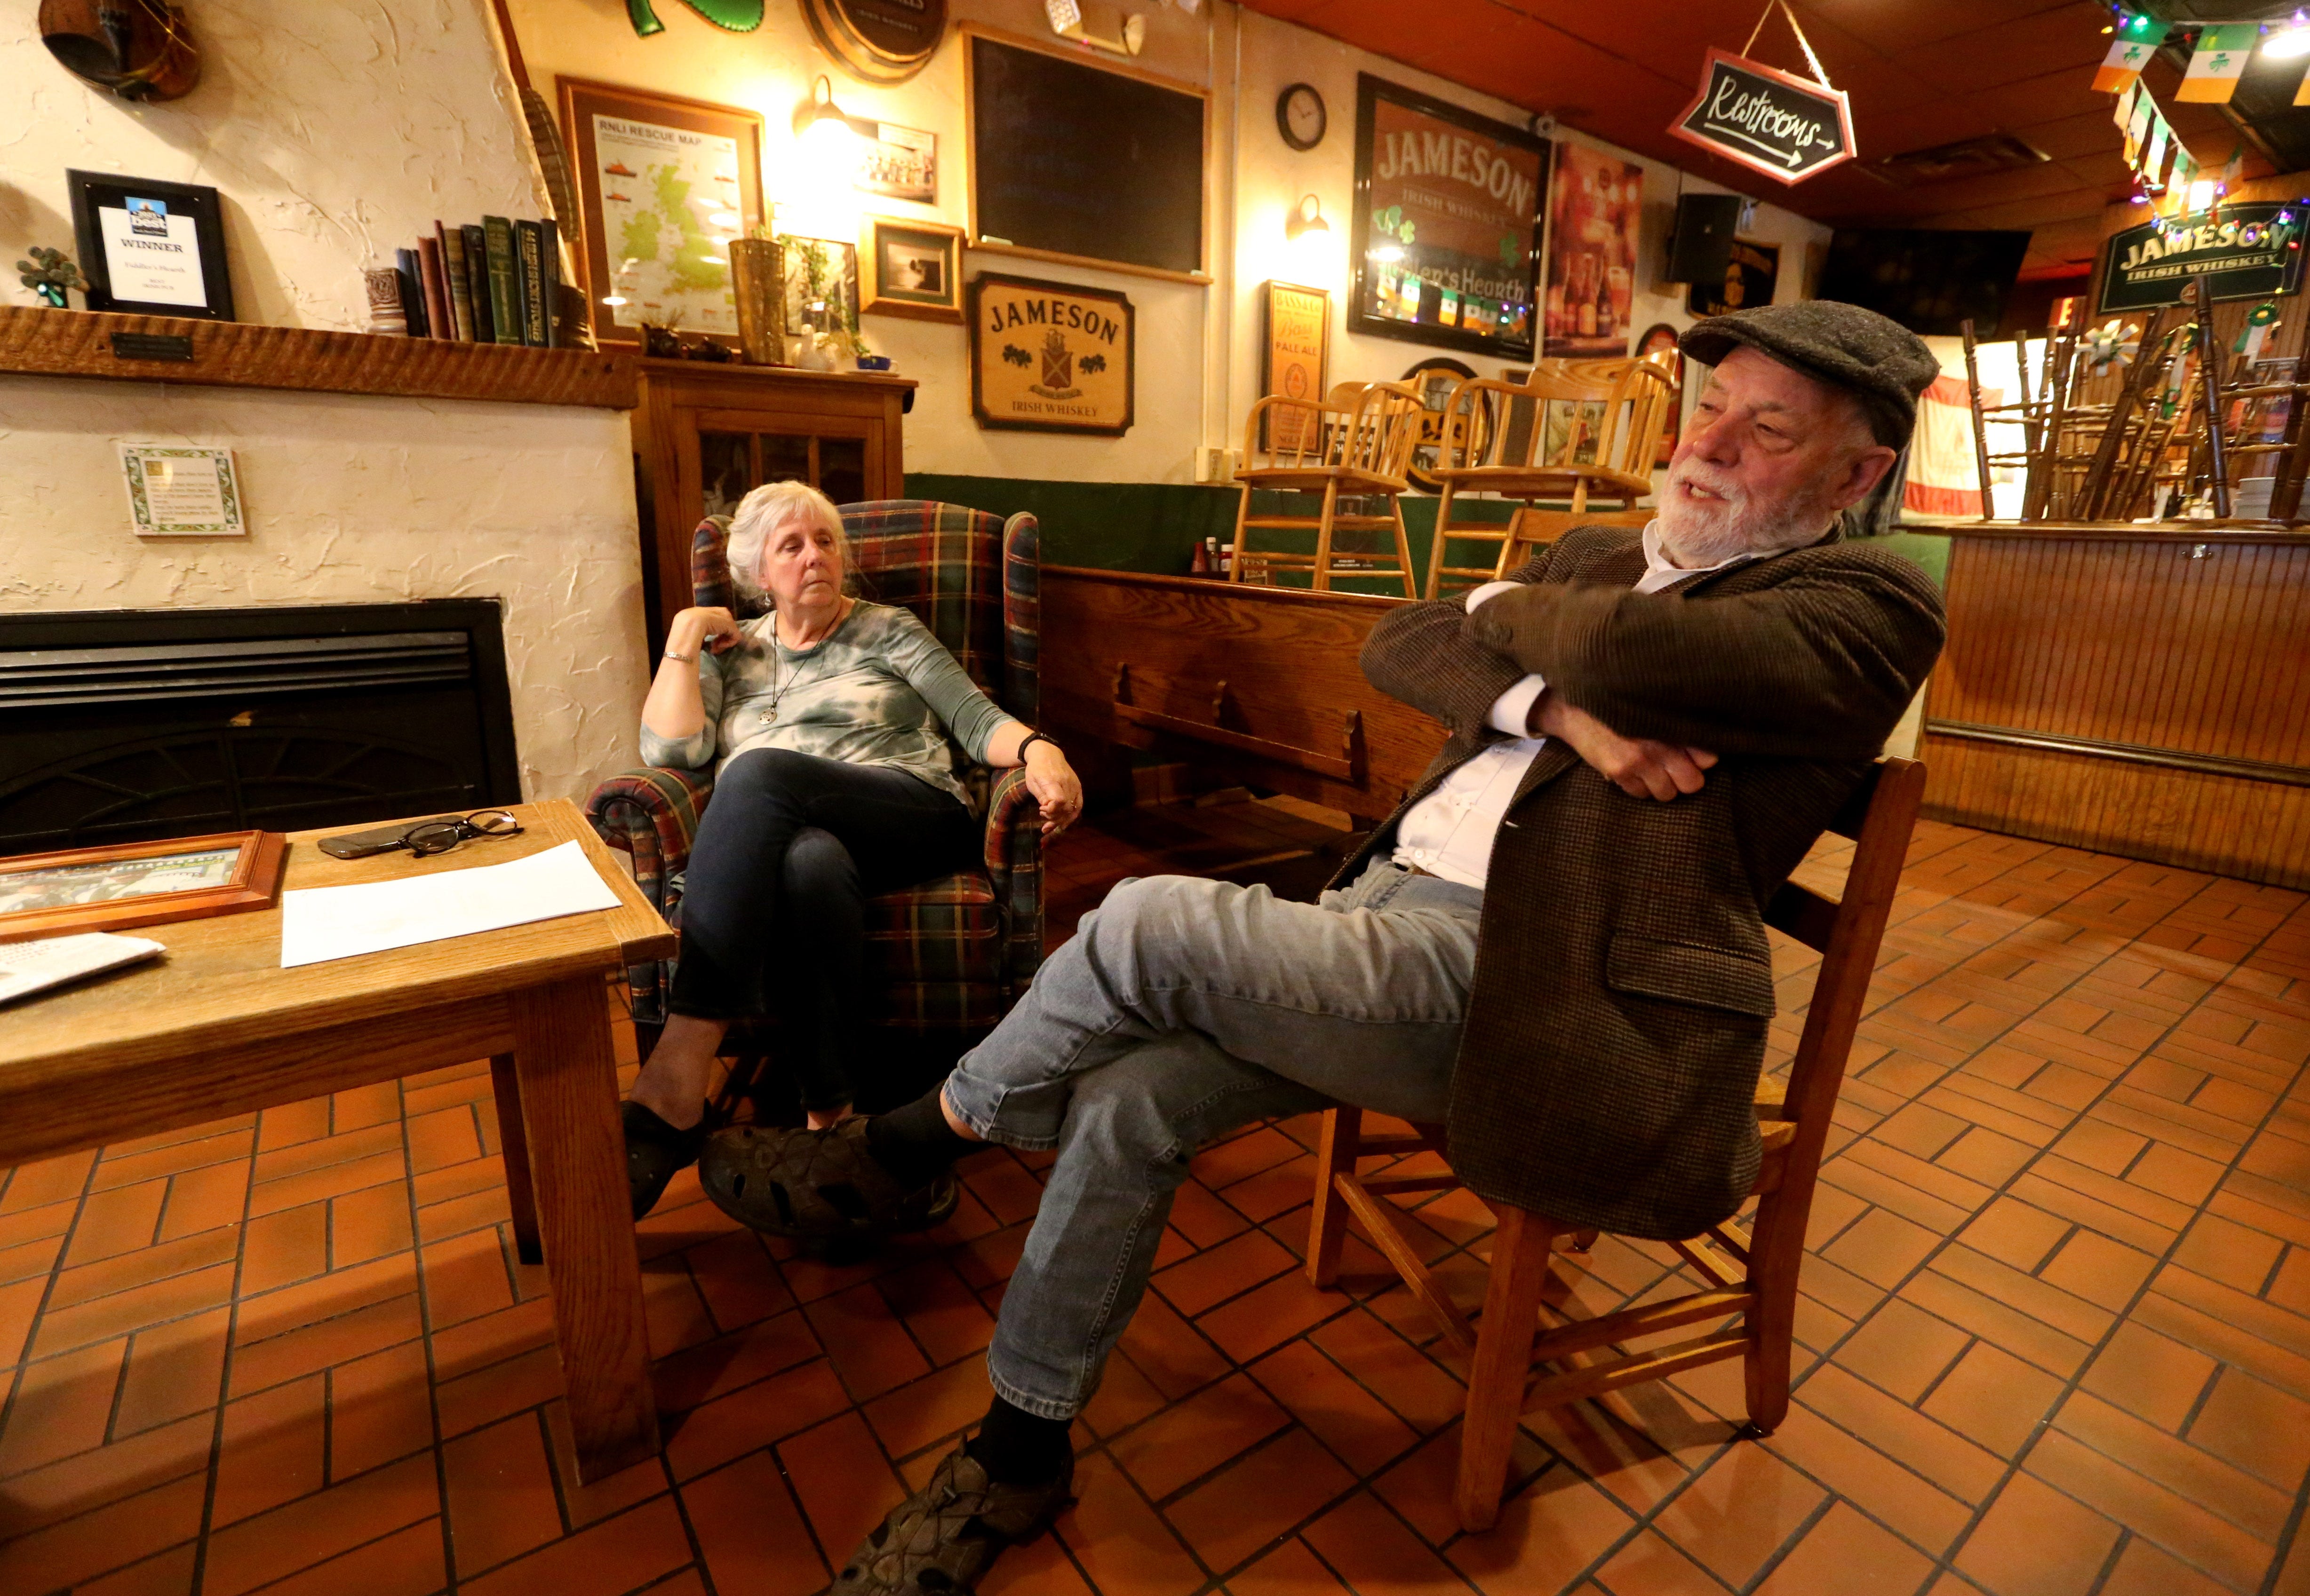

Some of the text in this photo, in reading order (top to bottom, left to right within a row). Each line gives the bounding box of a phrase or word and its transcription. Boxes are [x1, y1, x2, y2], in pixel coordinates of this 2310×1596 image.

[1707, 75, 1822, 147] Restrooms
[598, 119, 626, 134] RNLI
[629, 124, 675, 141] RESCUE
[678, 134, 702, 146] MAP
[1378, 130, 1532, 217] JAMESON
[121, 238, 183, 253] WINNER
[2119, 221, 2293, 271] JAMESON
[2126, 253, 2278, 282] IRISH WHISKEY
[990, 299, 1120, 346] JAMESON
[1275, 341, 1317, 357] PALE ALE
[1012, 400, 1099, 417] IRISH WHISKEY
